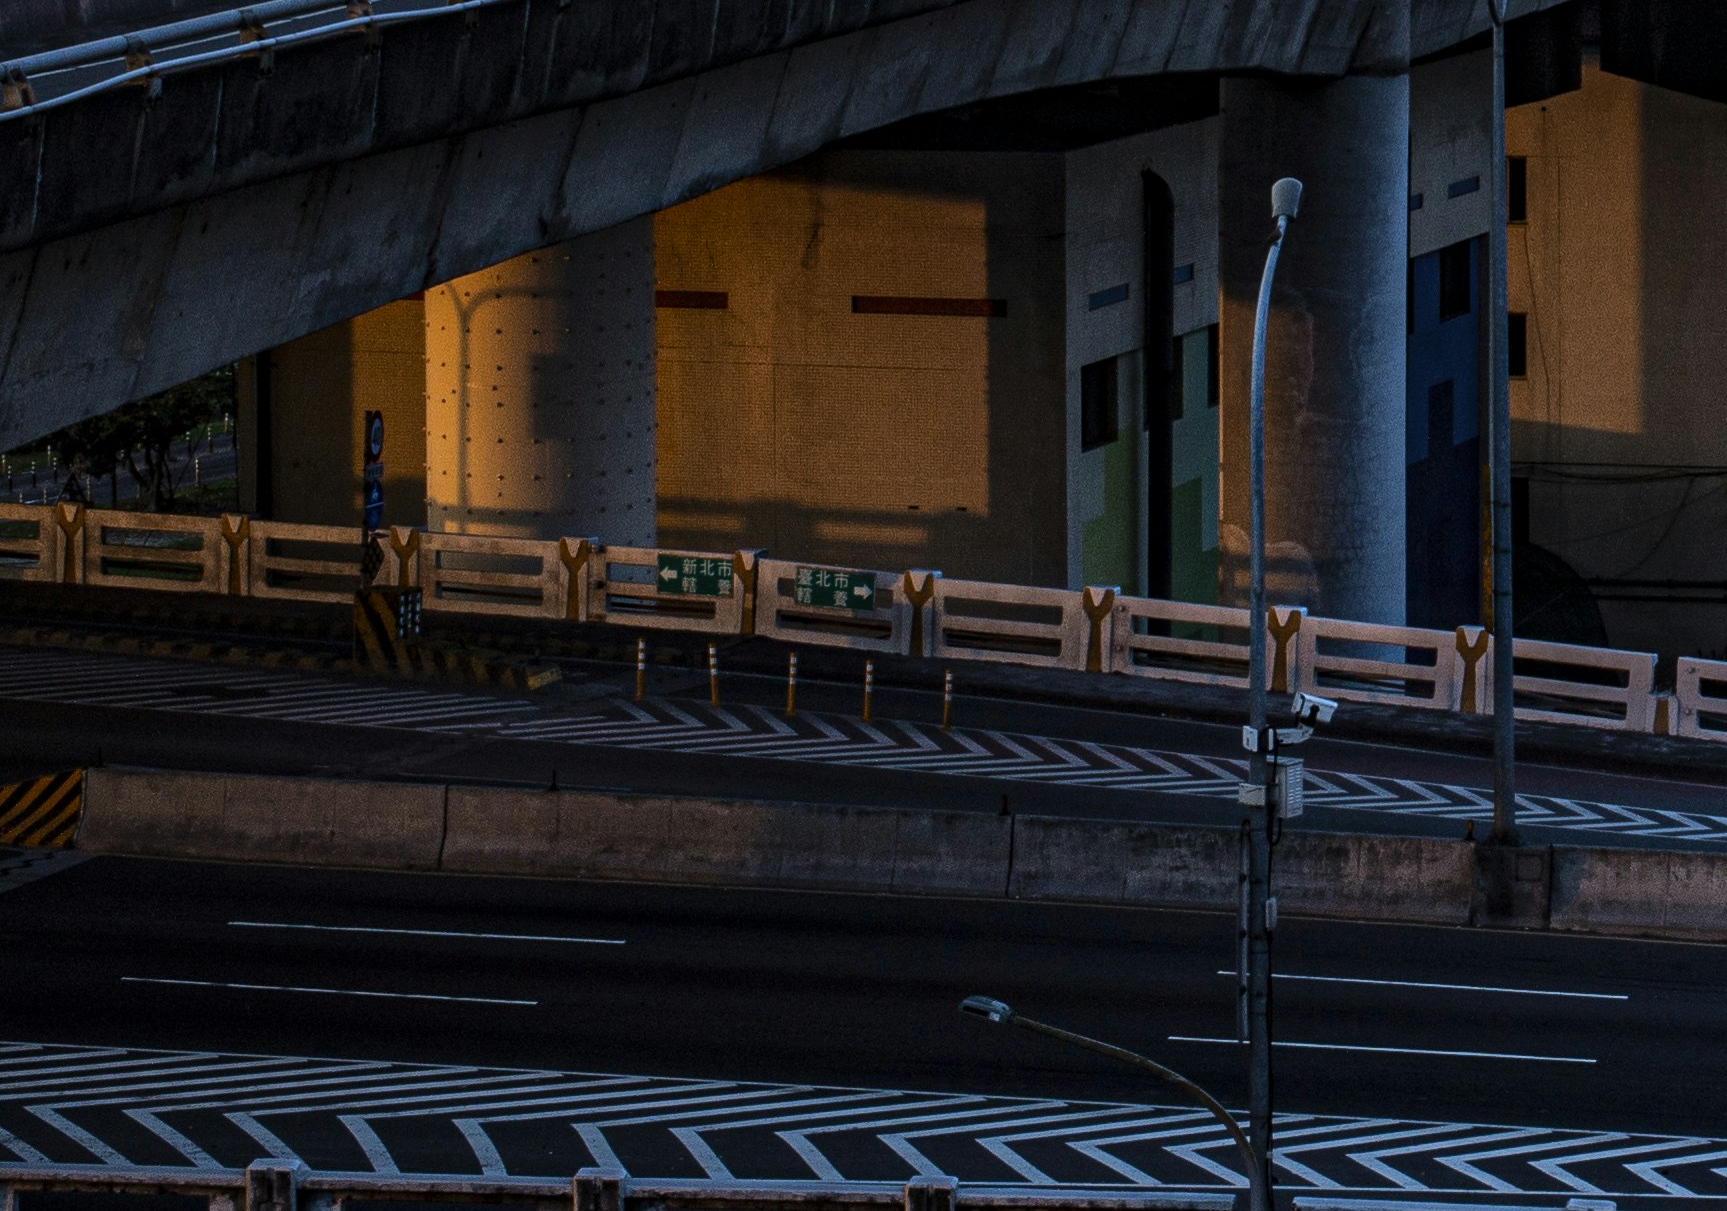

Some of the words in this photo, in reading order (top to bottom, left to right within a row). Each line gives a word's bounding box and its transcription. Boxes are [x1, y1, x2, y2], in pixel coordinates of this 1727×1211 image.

[682, 558, 732, 577] 新北市
[797, 567, 849, 589] 臺北市
